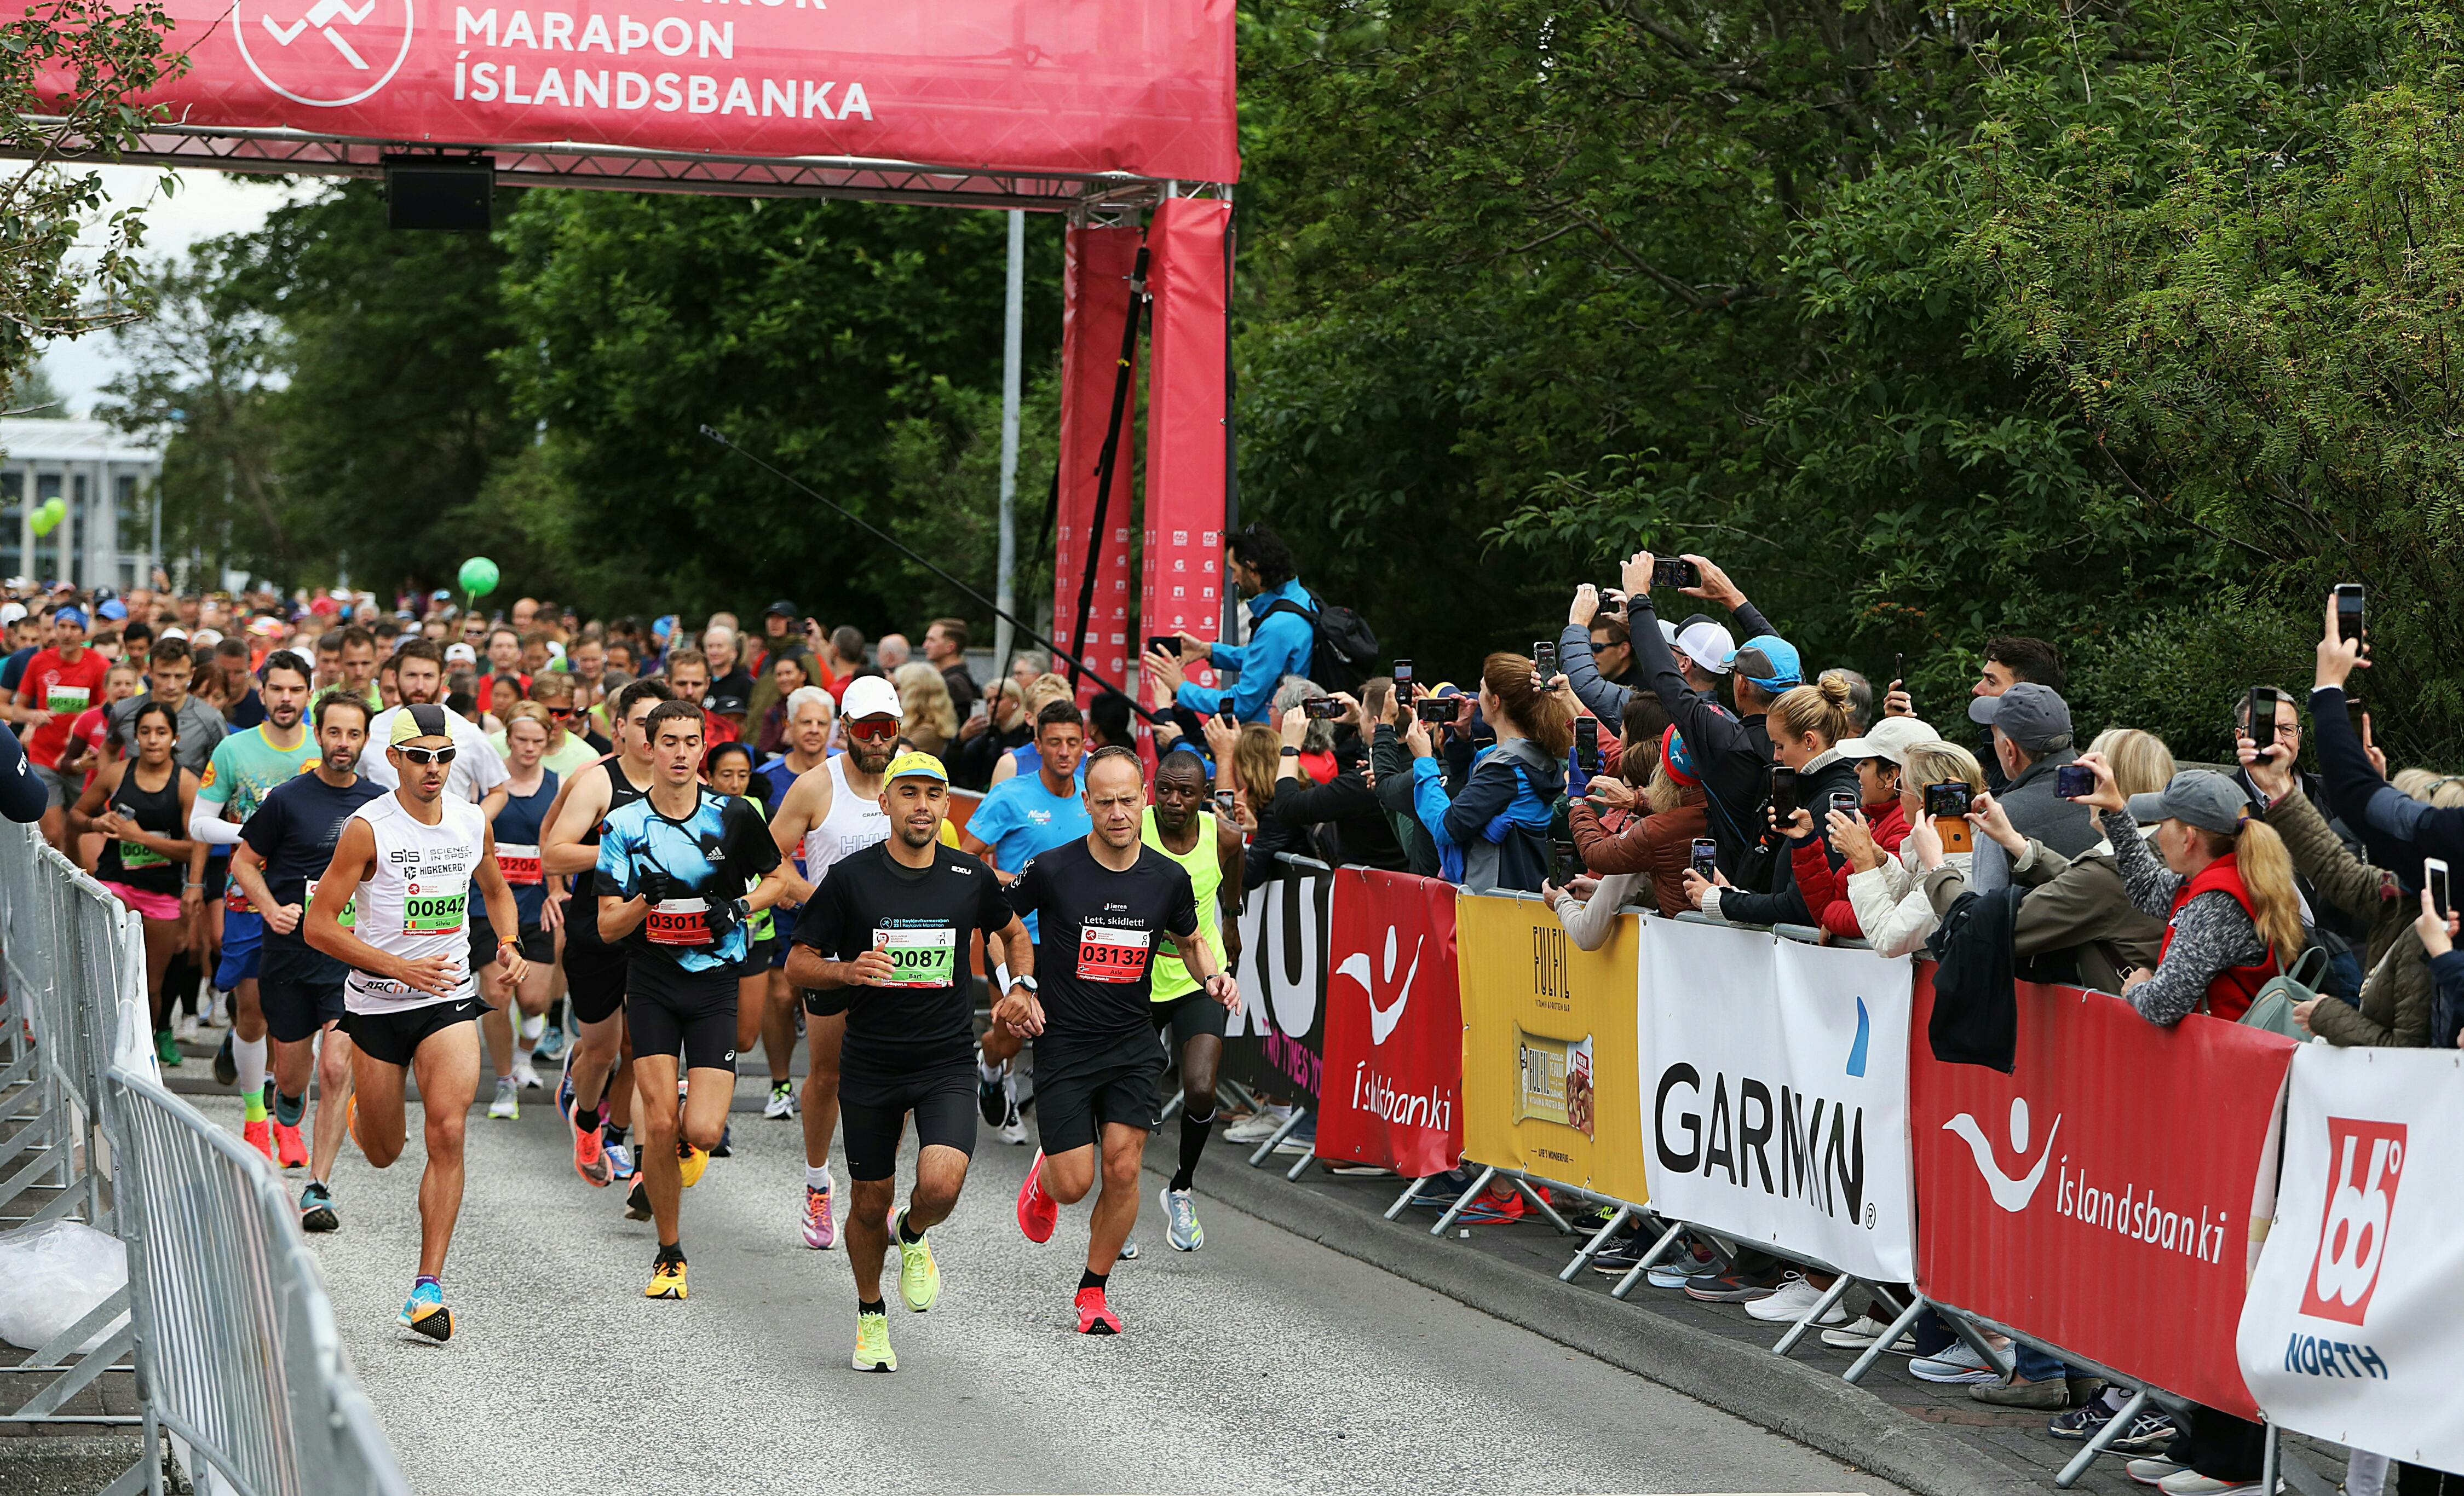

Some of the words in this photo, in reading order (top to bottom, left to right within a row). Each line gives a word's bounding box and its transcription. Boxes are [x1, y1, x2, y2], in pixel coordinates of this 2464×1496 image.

[455, 6, 734, 60] MARAÞON
[453, 50, 874, 122] ÍSLANDSBANKA
[430, 846, 469, 855] SCIENCE
[445, 852, 473, 860] SPORT
[500, 857, 537, 872] 3206
[951, 865, 972, 875] 2XU
[407, 896, 465, 917] 00842
[1085, 915, 1106, 925] Lett,
[1108, 916, 1144, 927] skidlett!
[883, 950, 947, 968] 0087
[1083, 945, 1146, 966] 03132
[1216, 876, 1317, 1038] XU
[1533, 926, 1569, 999] FULFIL
[1576, 1053, 1587, 1068] NEW
[2284, 1332, 2388, 1381] NORTH
